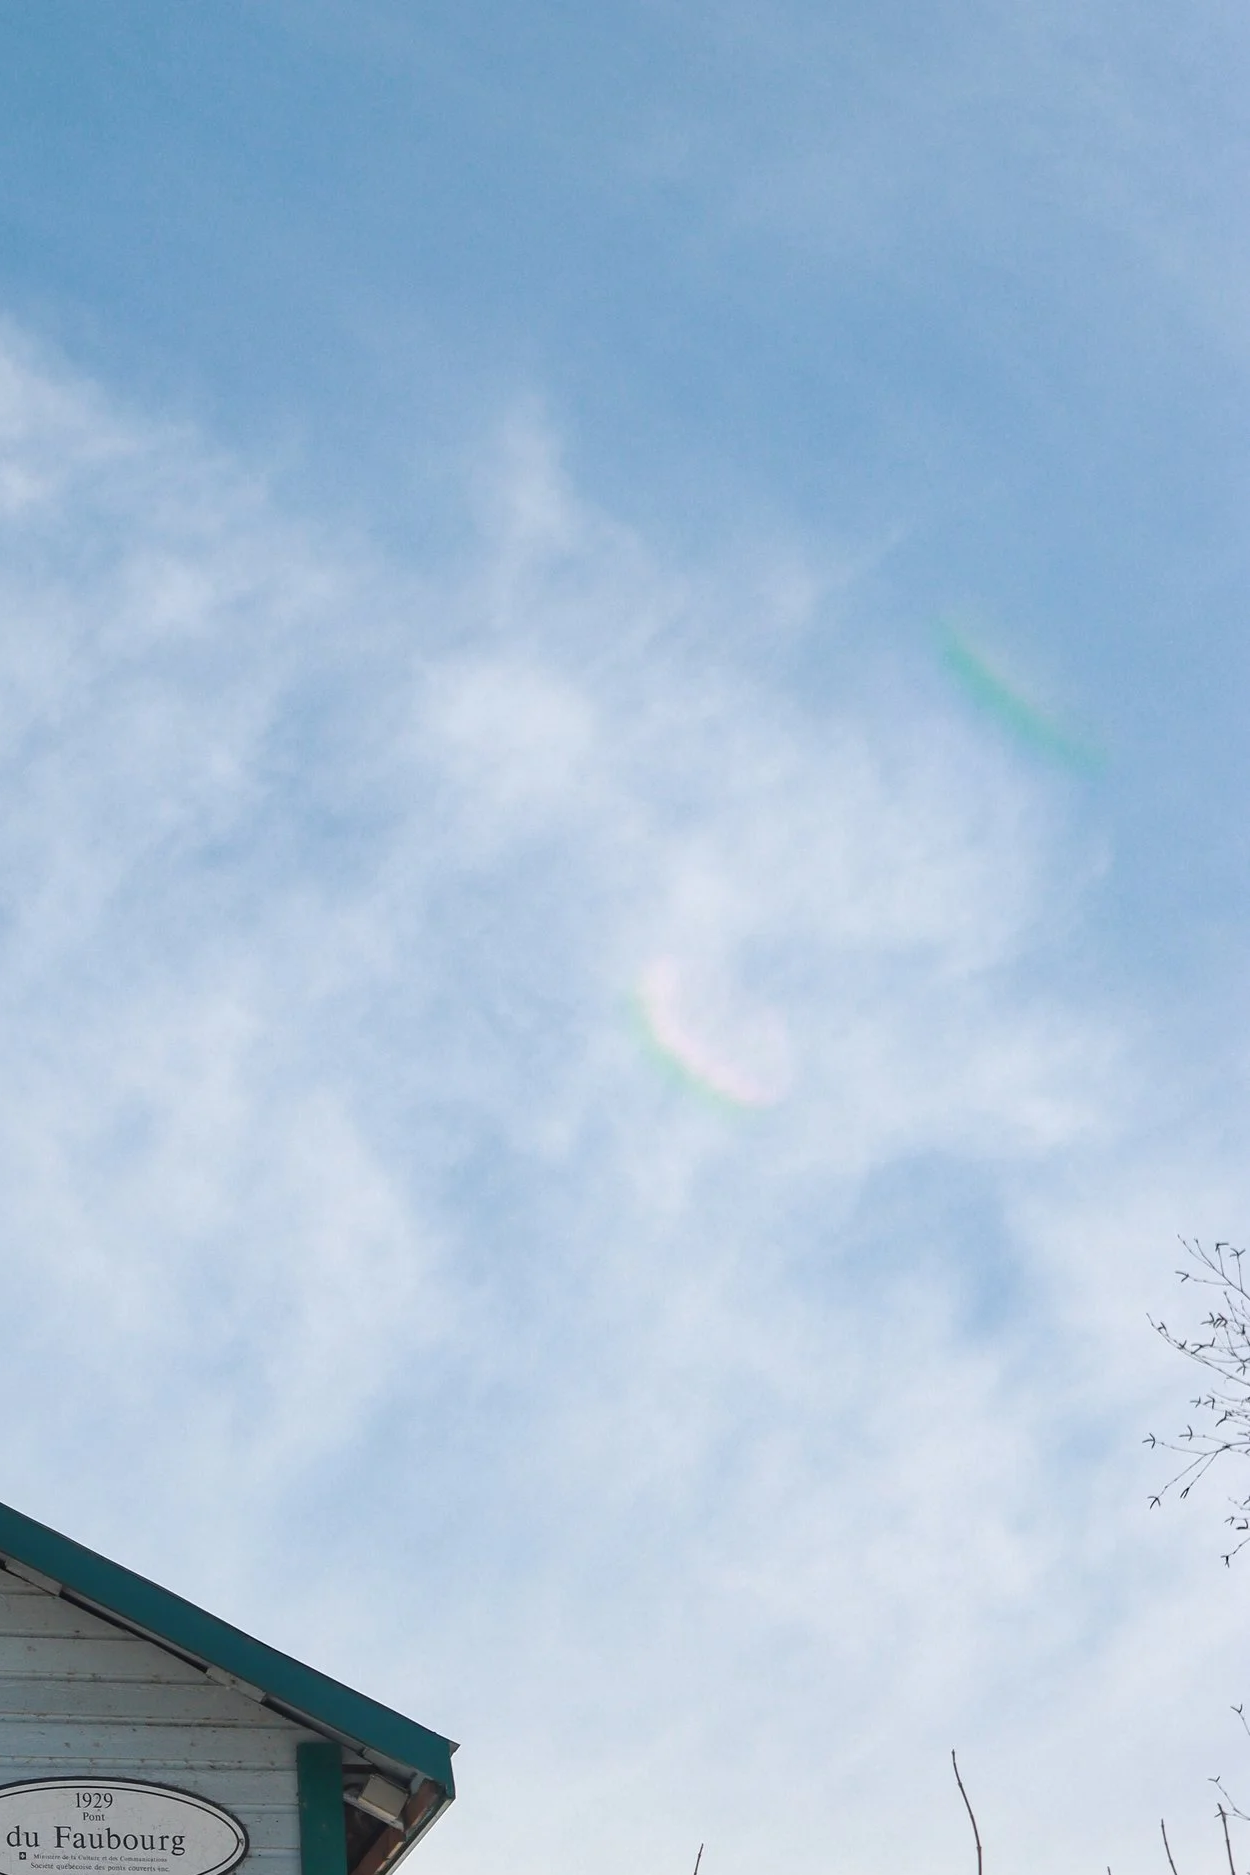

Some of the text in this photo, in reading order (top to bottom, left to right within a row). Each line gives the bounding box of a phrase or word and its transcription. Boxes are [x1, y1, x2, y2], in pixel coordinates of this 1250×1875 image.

[75, 1792, 113, 1809] 1929
[83, 1812, 105, 1821] Pont
[6, 1825, 186, 1855] du Faubourg
